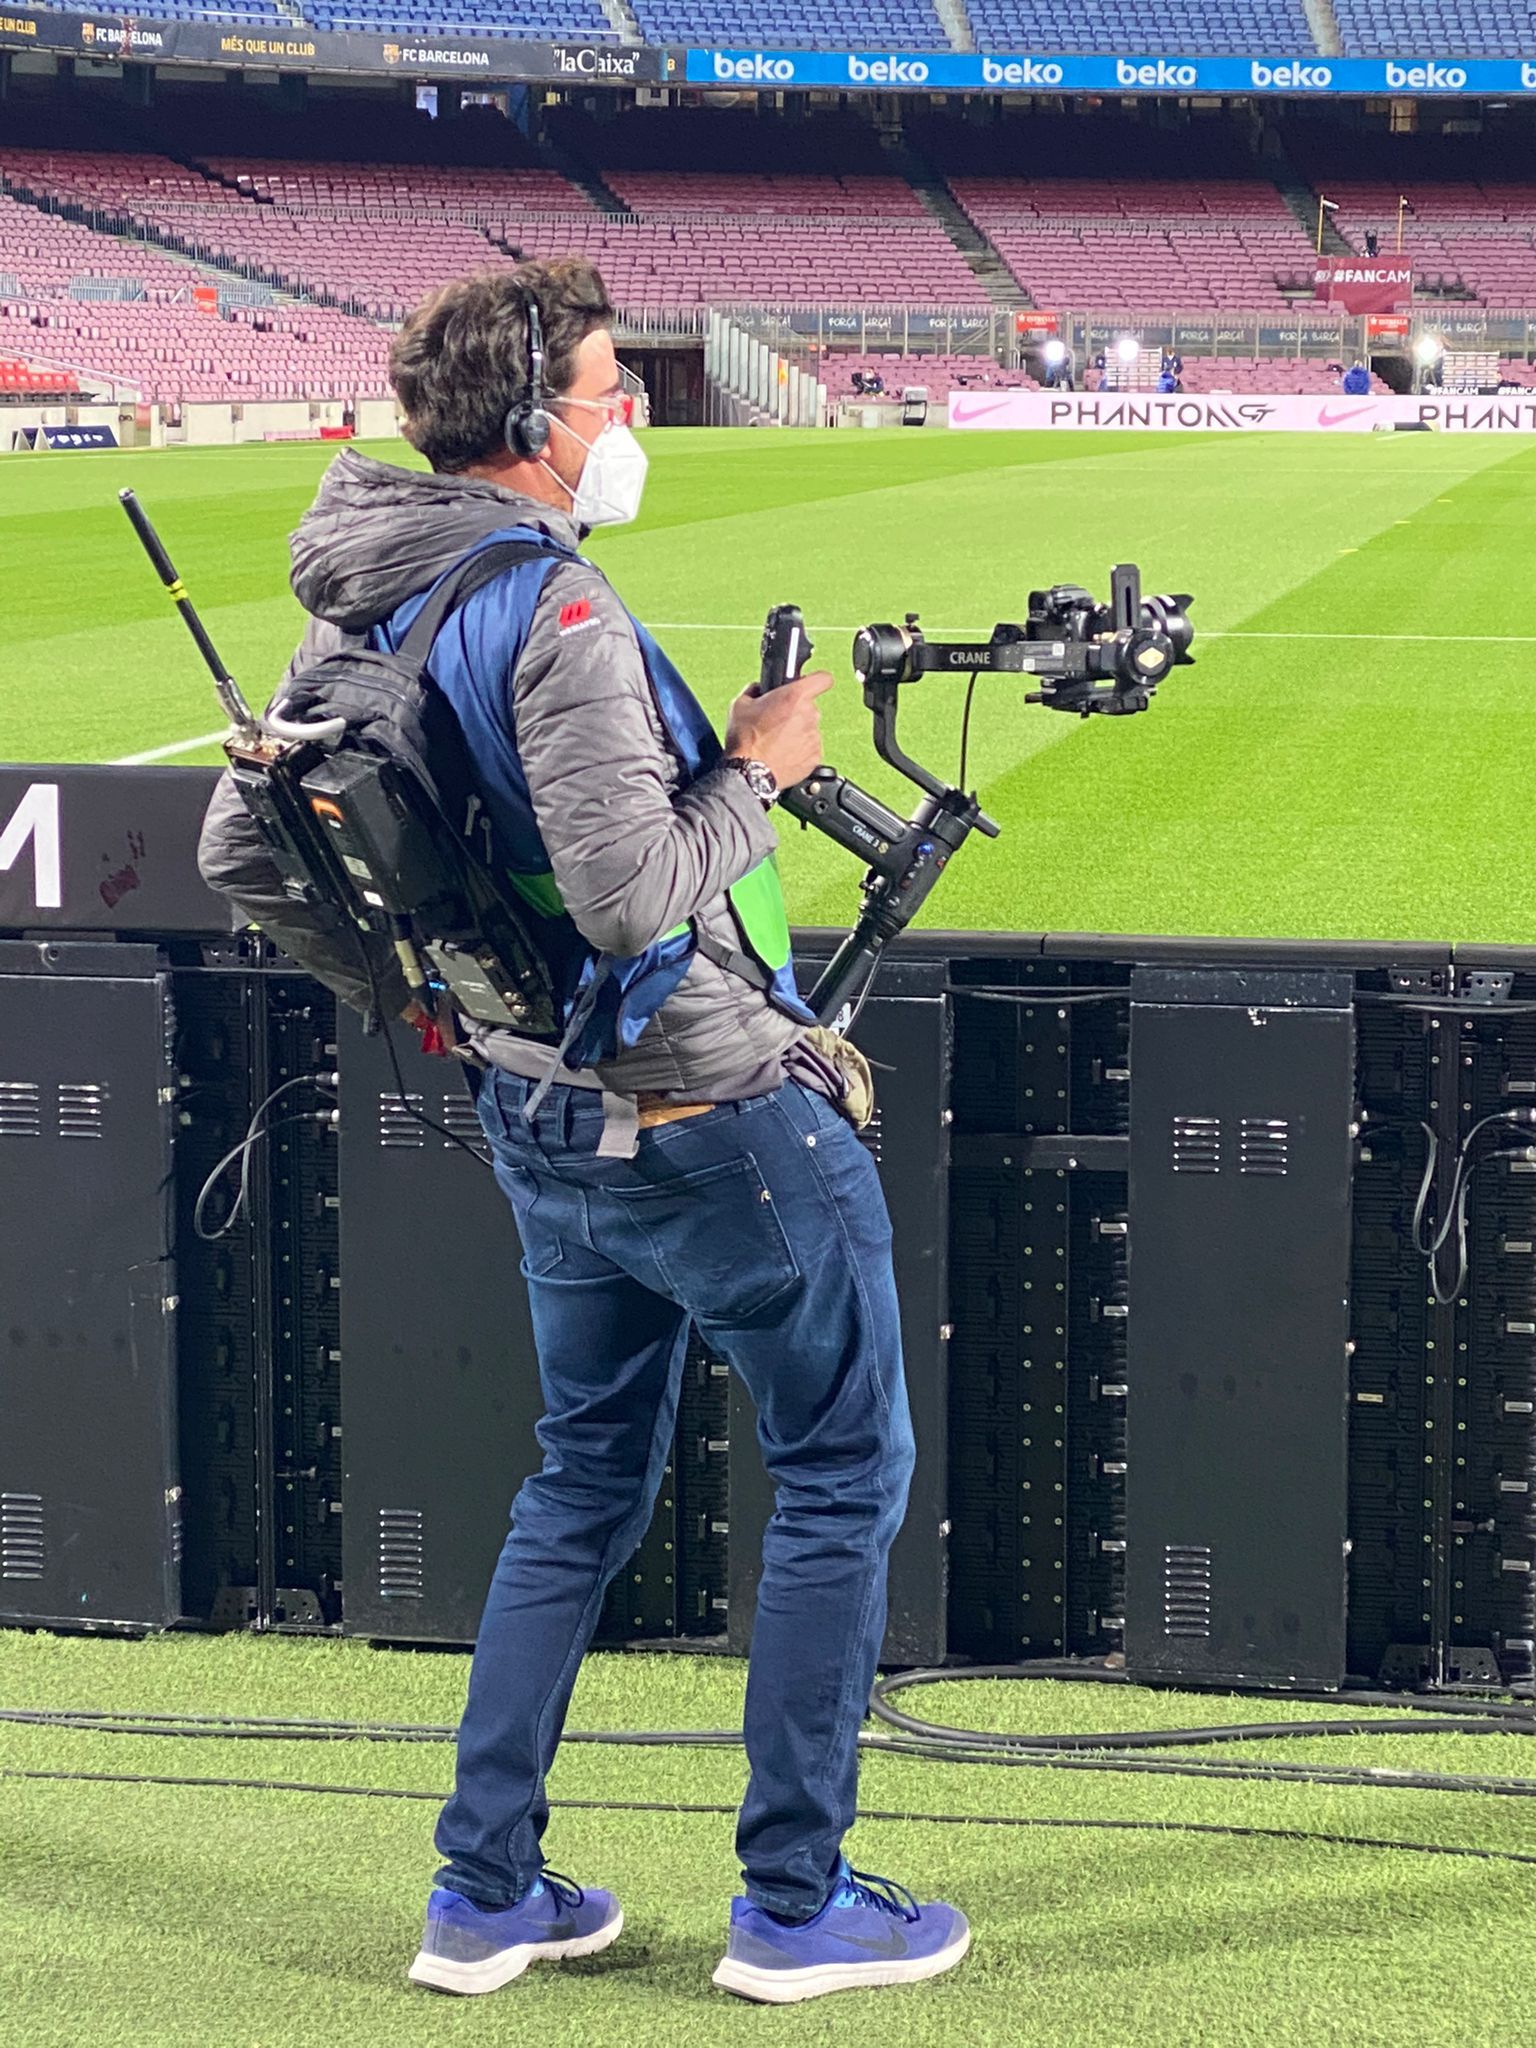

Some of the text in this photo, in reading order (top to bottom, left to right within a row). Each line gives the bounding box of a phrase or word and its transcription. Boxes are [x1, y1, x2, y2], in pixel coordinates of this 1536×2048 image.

[4, 19, 16, 33] UN
[16, 20, 37, 36] CLUB
[96, 27, 108, 42] FC
[221, 35, 315, 56] MÉS QUE UN CLUB
[402, 49, 489, 66] FC BARCELONA
[714, 52, 795, 80] beko
[849, 55, 929, 82] beko
[982, 57, 1063, 84] beko
[1117, 59, 1197, 86] beko
[1251, 61, 1332, 87] beko
[1386, 62, 1466, 88] beko
[1333, 268, 1411, 283] #FANCAM
[1050, 401, 1242, 427] PHANTOM
[949, 651, 991, 665] CRANE
[852, 825, 875, 844] CRANE
